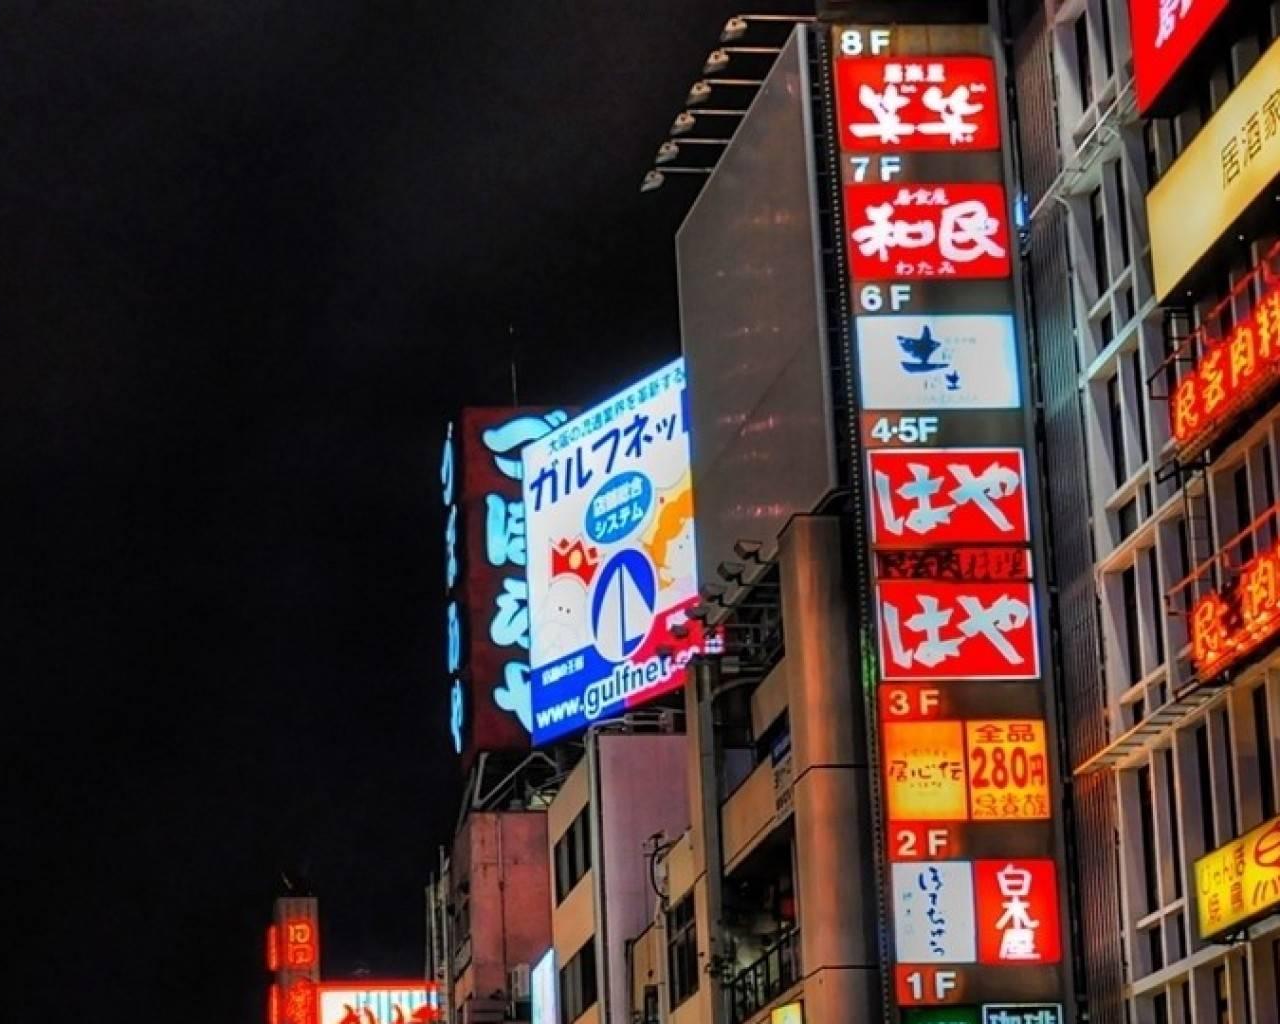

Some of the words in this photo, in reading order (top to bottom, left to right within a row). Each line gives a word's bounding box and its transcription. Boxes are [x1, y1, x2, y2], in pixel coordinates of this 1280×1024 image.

[841, 30, 890, 55] 8F
[850, 157, 901, 182] 7F
[852, 200, 1005, 261] 和民
[861, 285, 911, 311] 6F
[874, 462, 1019, 536] はや
[883, 594, 1029, 669] はや
[889, 690, 940, 715] 3F
[975, 724, 1035, 744] 全品
[972, 747, 1046, 789] 280円
[897, 830, 948, 856] 2F
[995, 865, 1042, 960] 白木屋
[906, 971, 956, 1000] 1F
